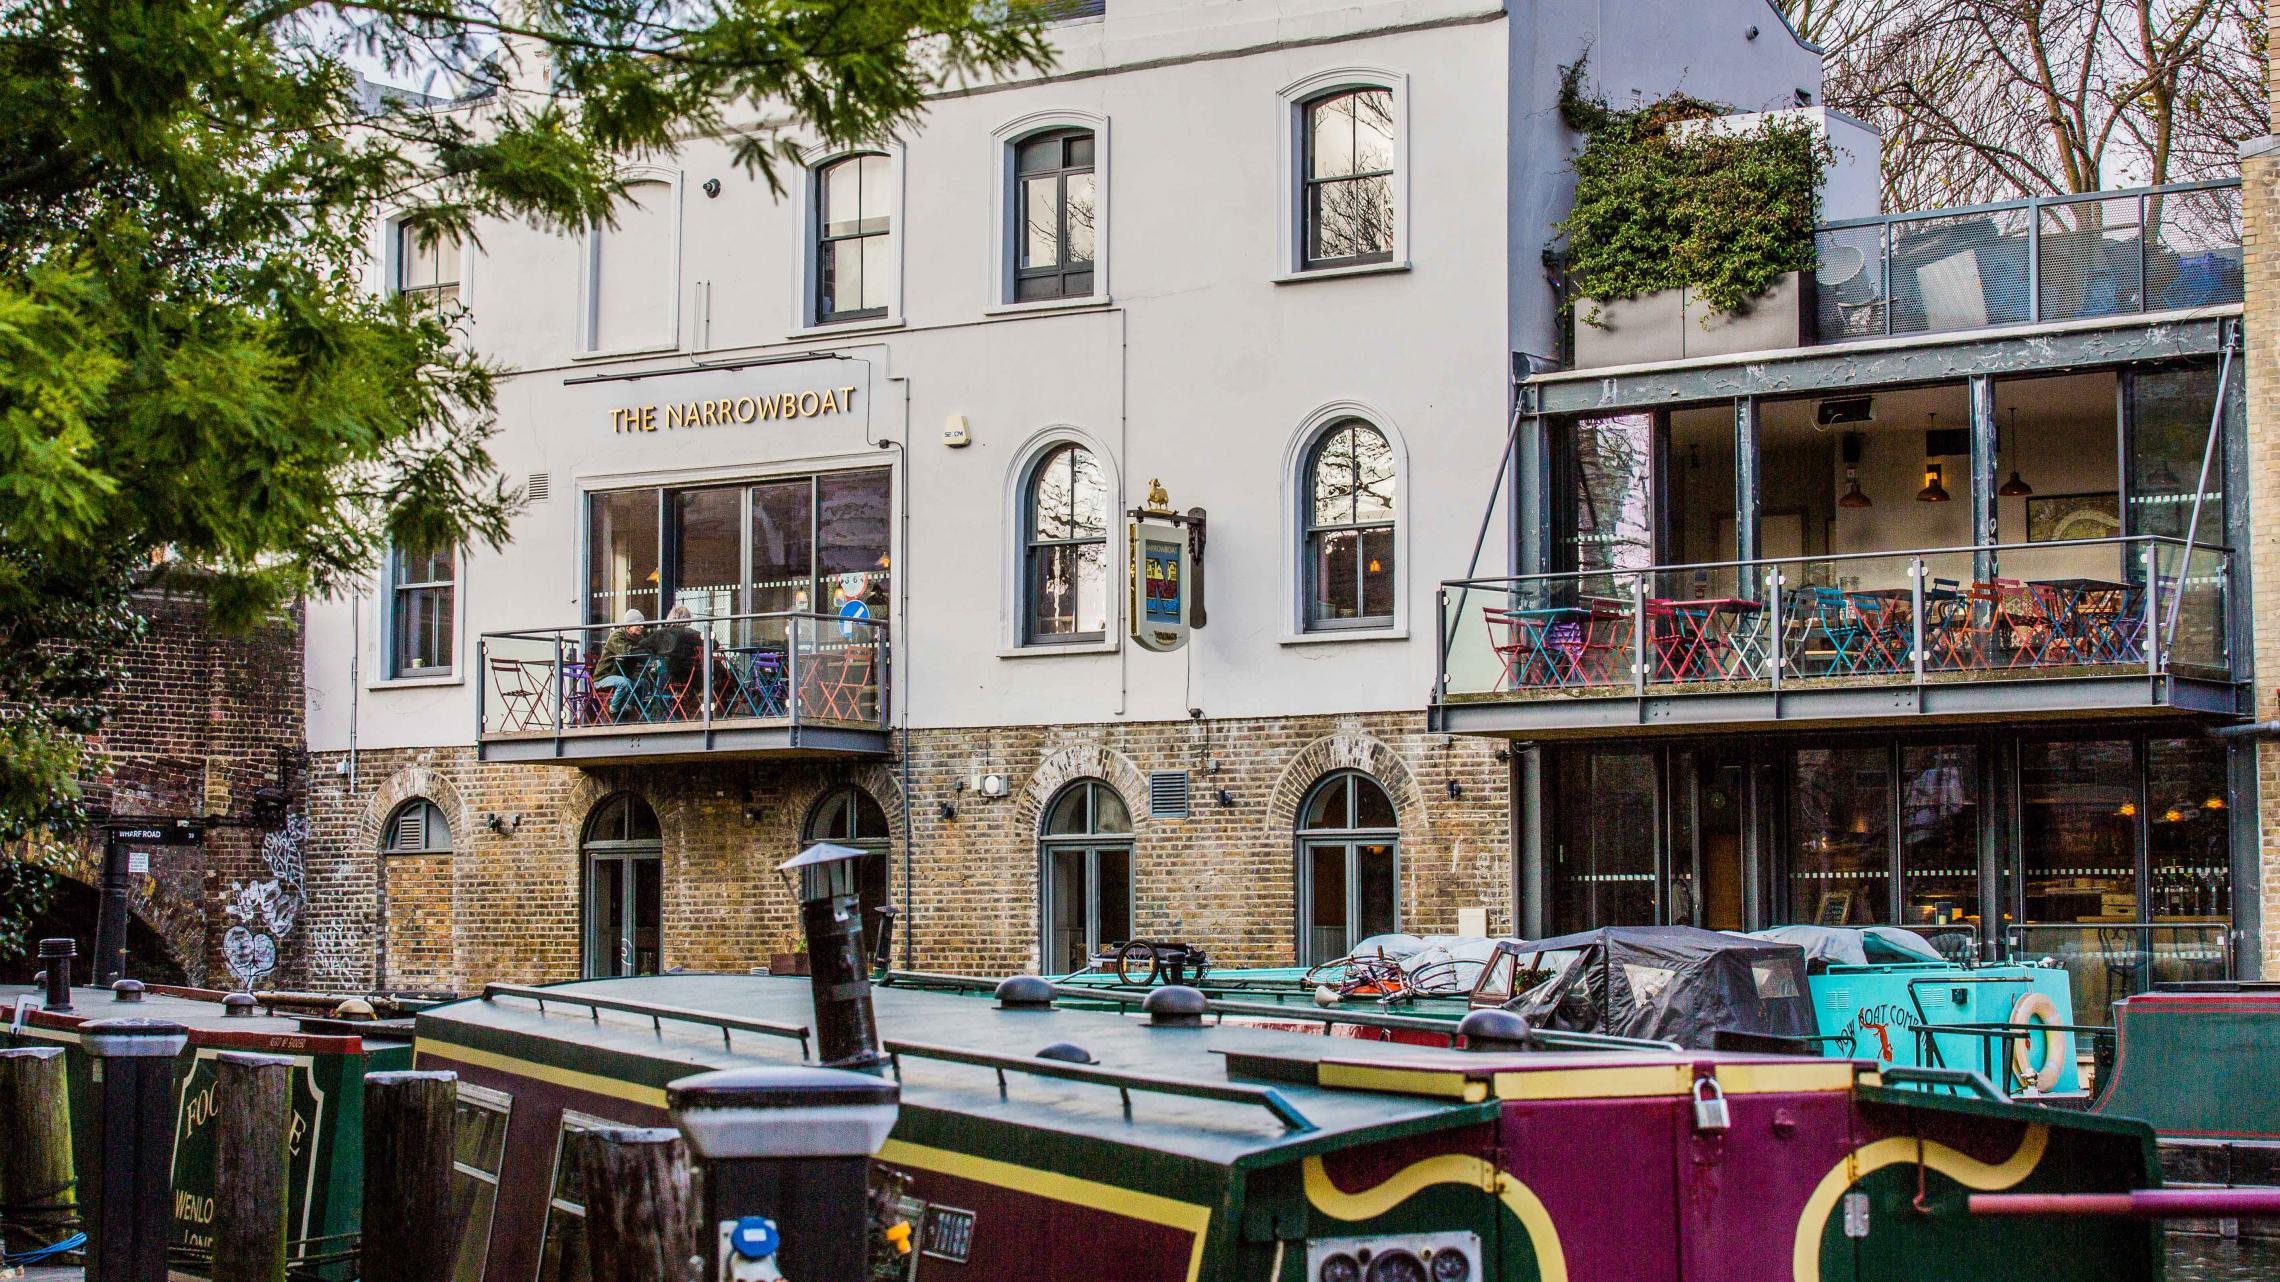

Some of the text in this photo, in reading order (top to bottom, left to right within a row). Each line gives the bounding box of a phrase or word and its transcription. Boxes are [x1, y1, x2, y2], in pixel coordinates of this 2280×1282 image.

[608, 386, 857, 434] THE NARROWBOAT
[119, 830, 142, 838] WHARF
[142, 830, 161, 839] ROAD
